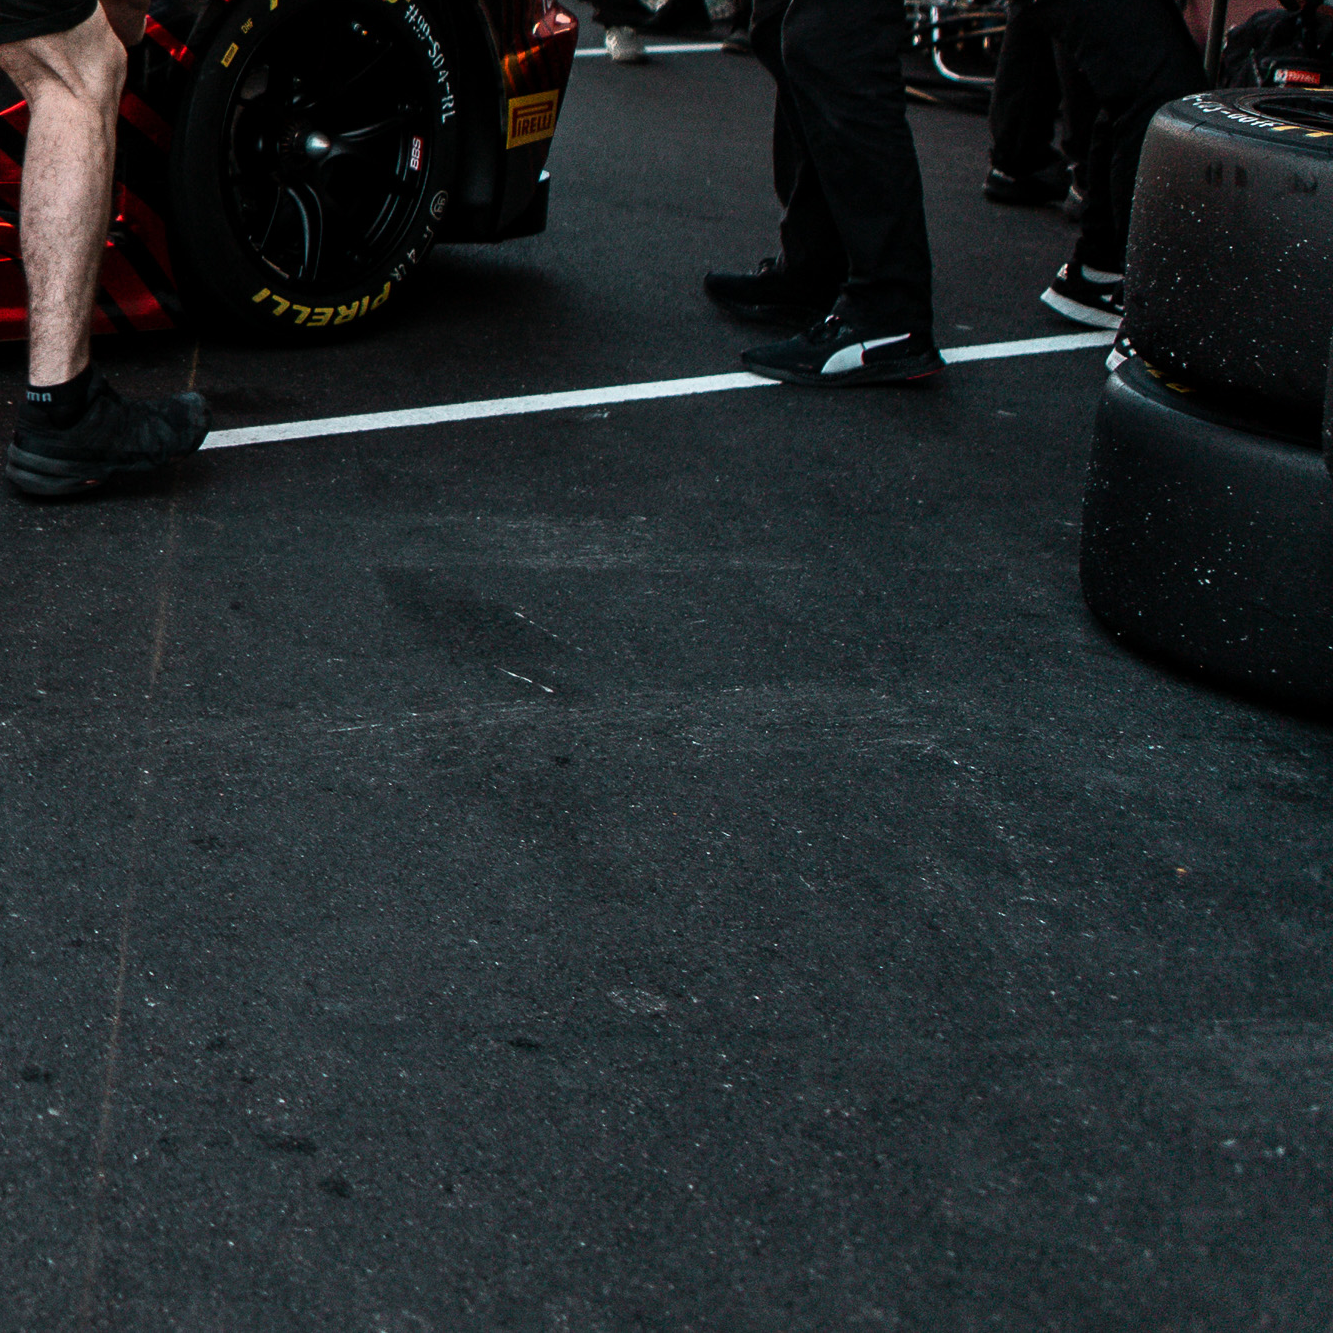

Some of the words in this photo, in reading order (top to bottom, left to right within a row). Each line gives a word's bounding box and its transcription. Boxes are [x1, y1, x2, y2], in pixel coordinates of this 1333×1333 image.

[511, 100, 554, 140] PIRELLI
[410, 137, 422, 170] BBS
[251, 280, 392, 327] PIRELLI
